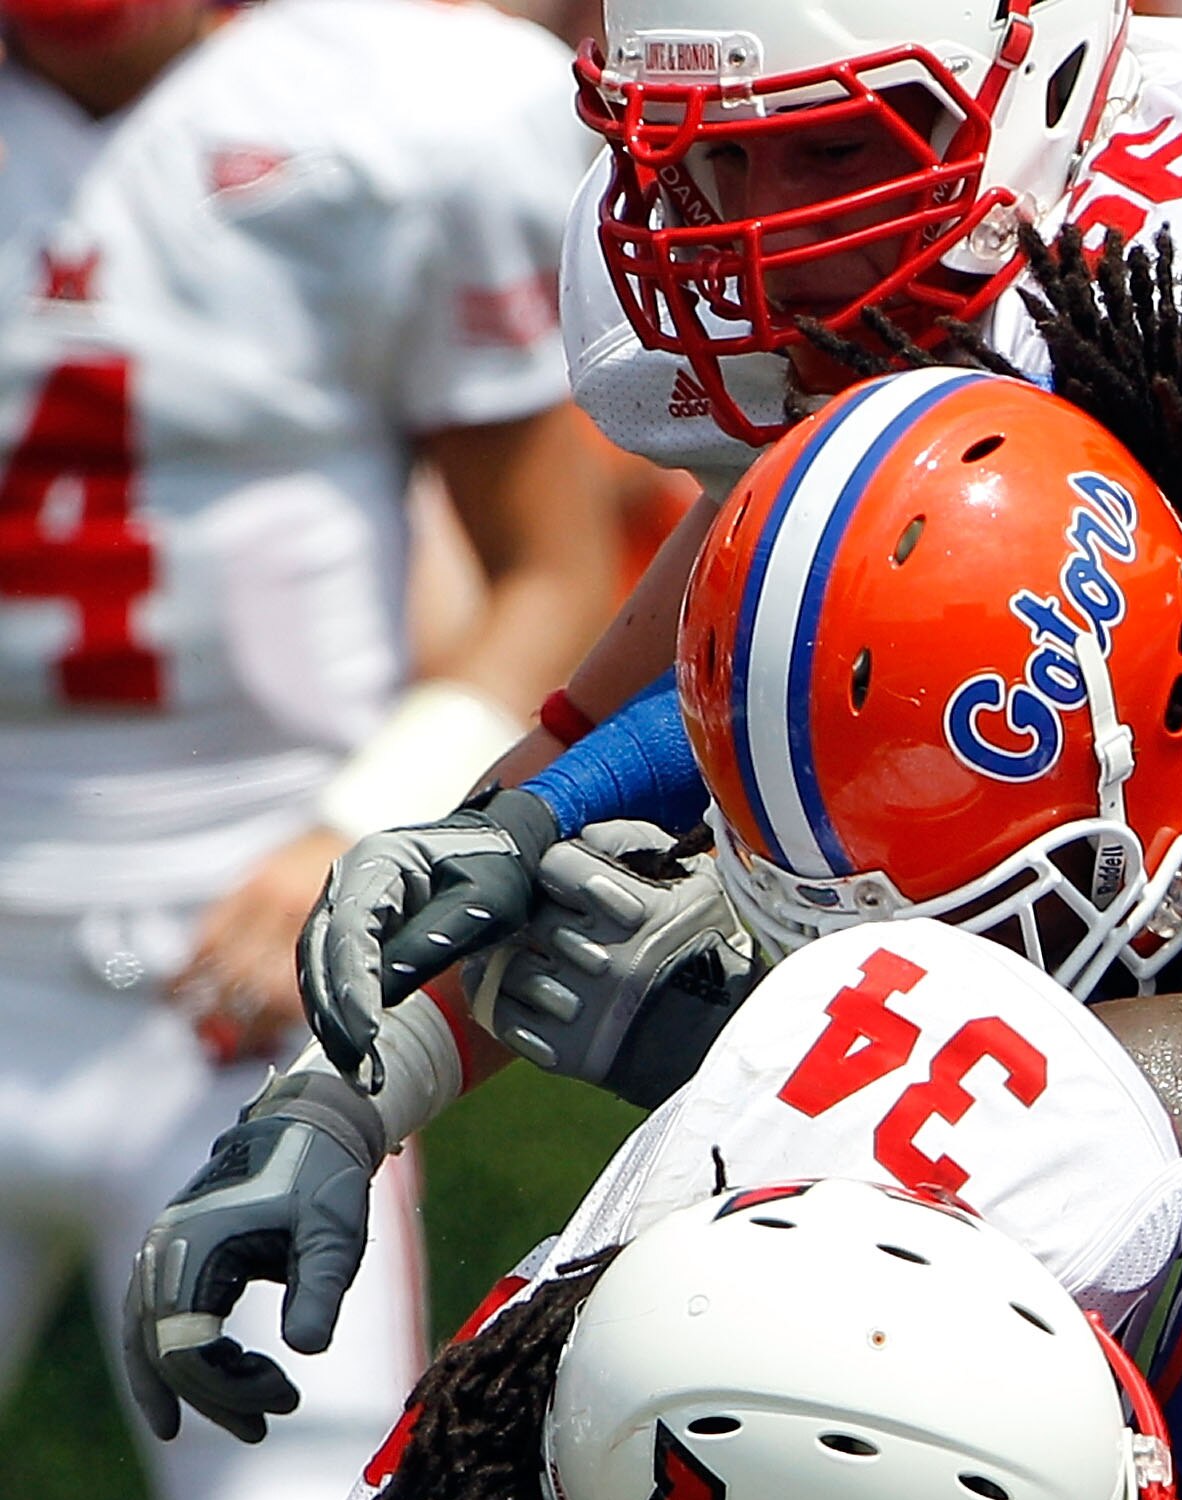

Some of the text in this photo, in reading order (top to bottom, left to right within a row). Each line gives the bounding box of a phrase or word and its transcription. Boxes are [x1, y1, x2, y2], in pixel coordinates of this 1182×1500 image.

[677, 42, 717, 70] HONOR
[943, 470, 1139, 783] Gators
[777, 946, 1048, 1200] 34
